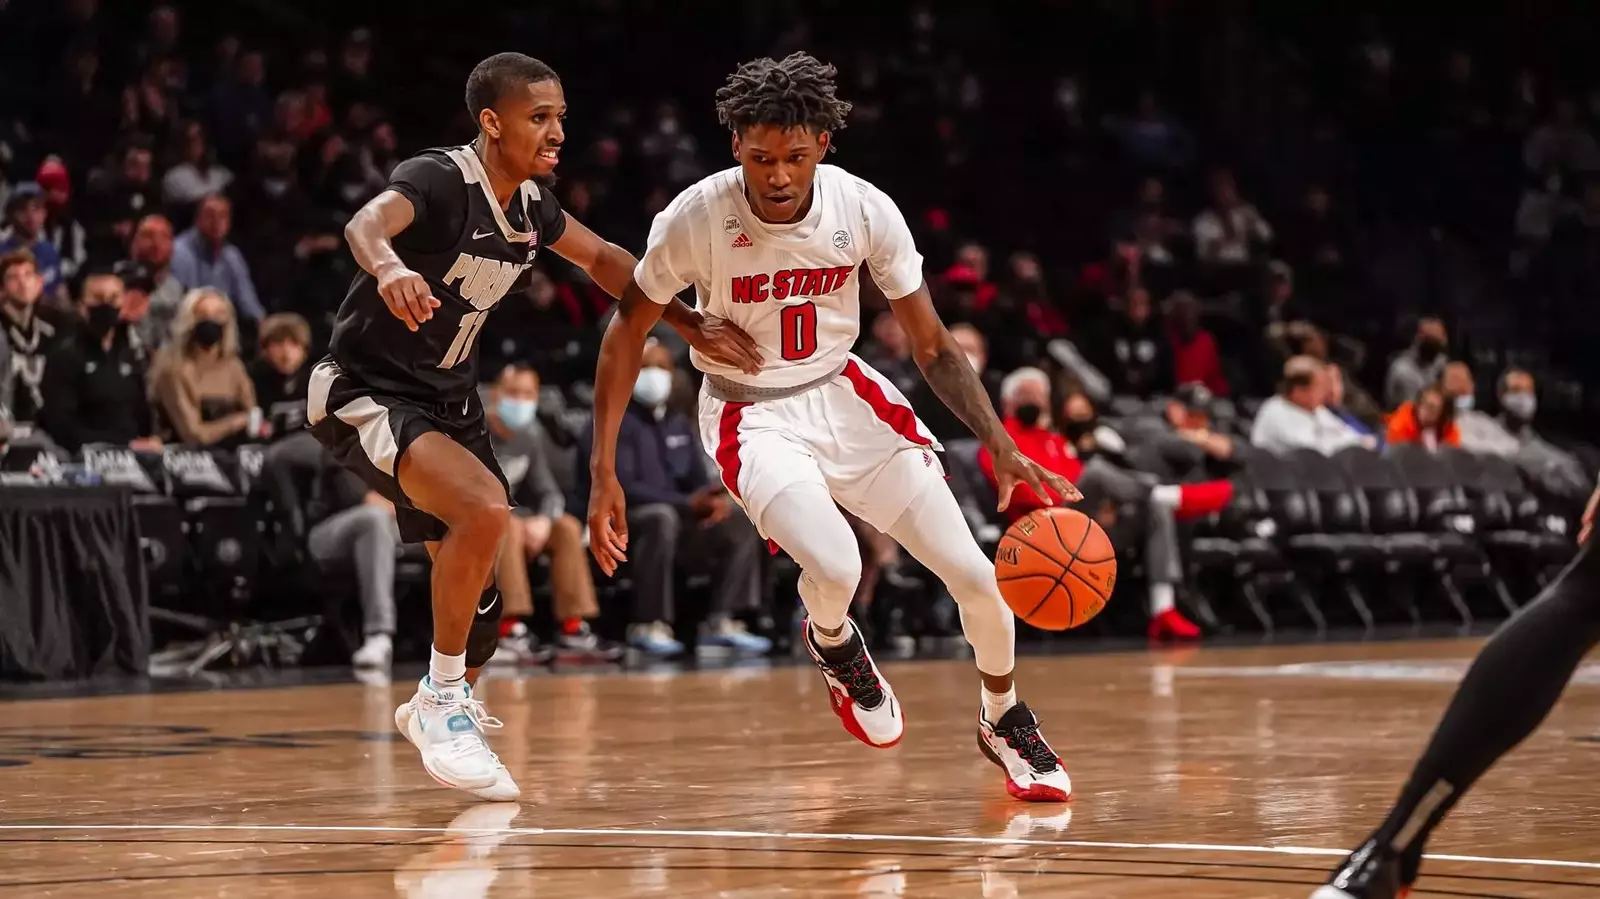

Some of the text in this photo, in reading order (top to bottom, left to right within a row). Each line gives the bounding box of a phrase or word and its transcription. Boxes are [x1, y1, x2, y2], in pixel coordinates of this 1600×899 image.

[442, 252, 533, 311] PURD
[731, 264, 856, 304] NC STATE
[436, 310, 489, 370] 11
[780, 300, 818, 361] 0
